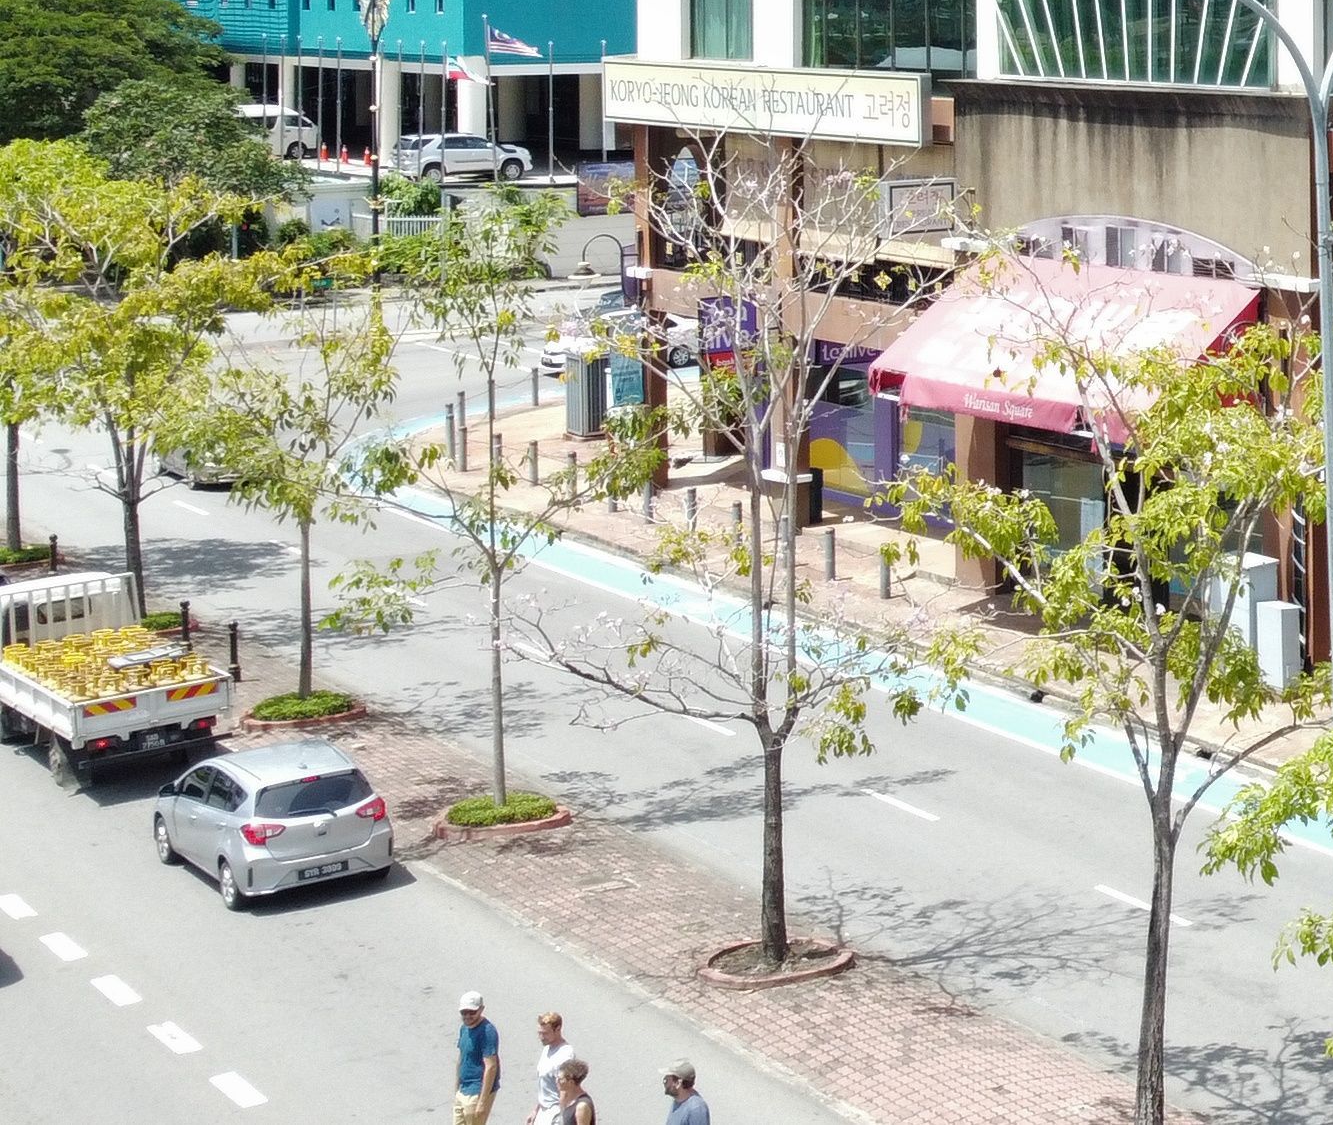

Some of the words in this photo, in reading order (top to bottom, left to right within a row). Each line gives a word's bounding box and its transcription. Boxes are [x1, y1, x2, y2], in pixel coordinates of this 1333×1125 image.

[703, 85, 757, 111] KOREAN
[762, 89, 854, 119] RESTAURANT
[863, 90, 912, 128] 고려정
[1002, 400, 1033, 420] Square
